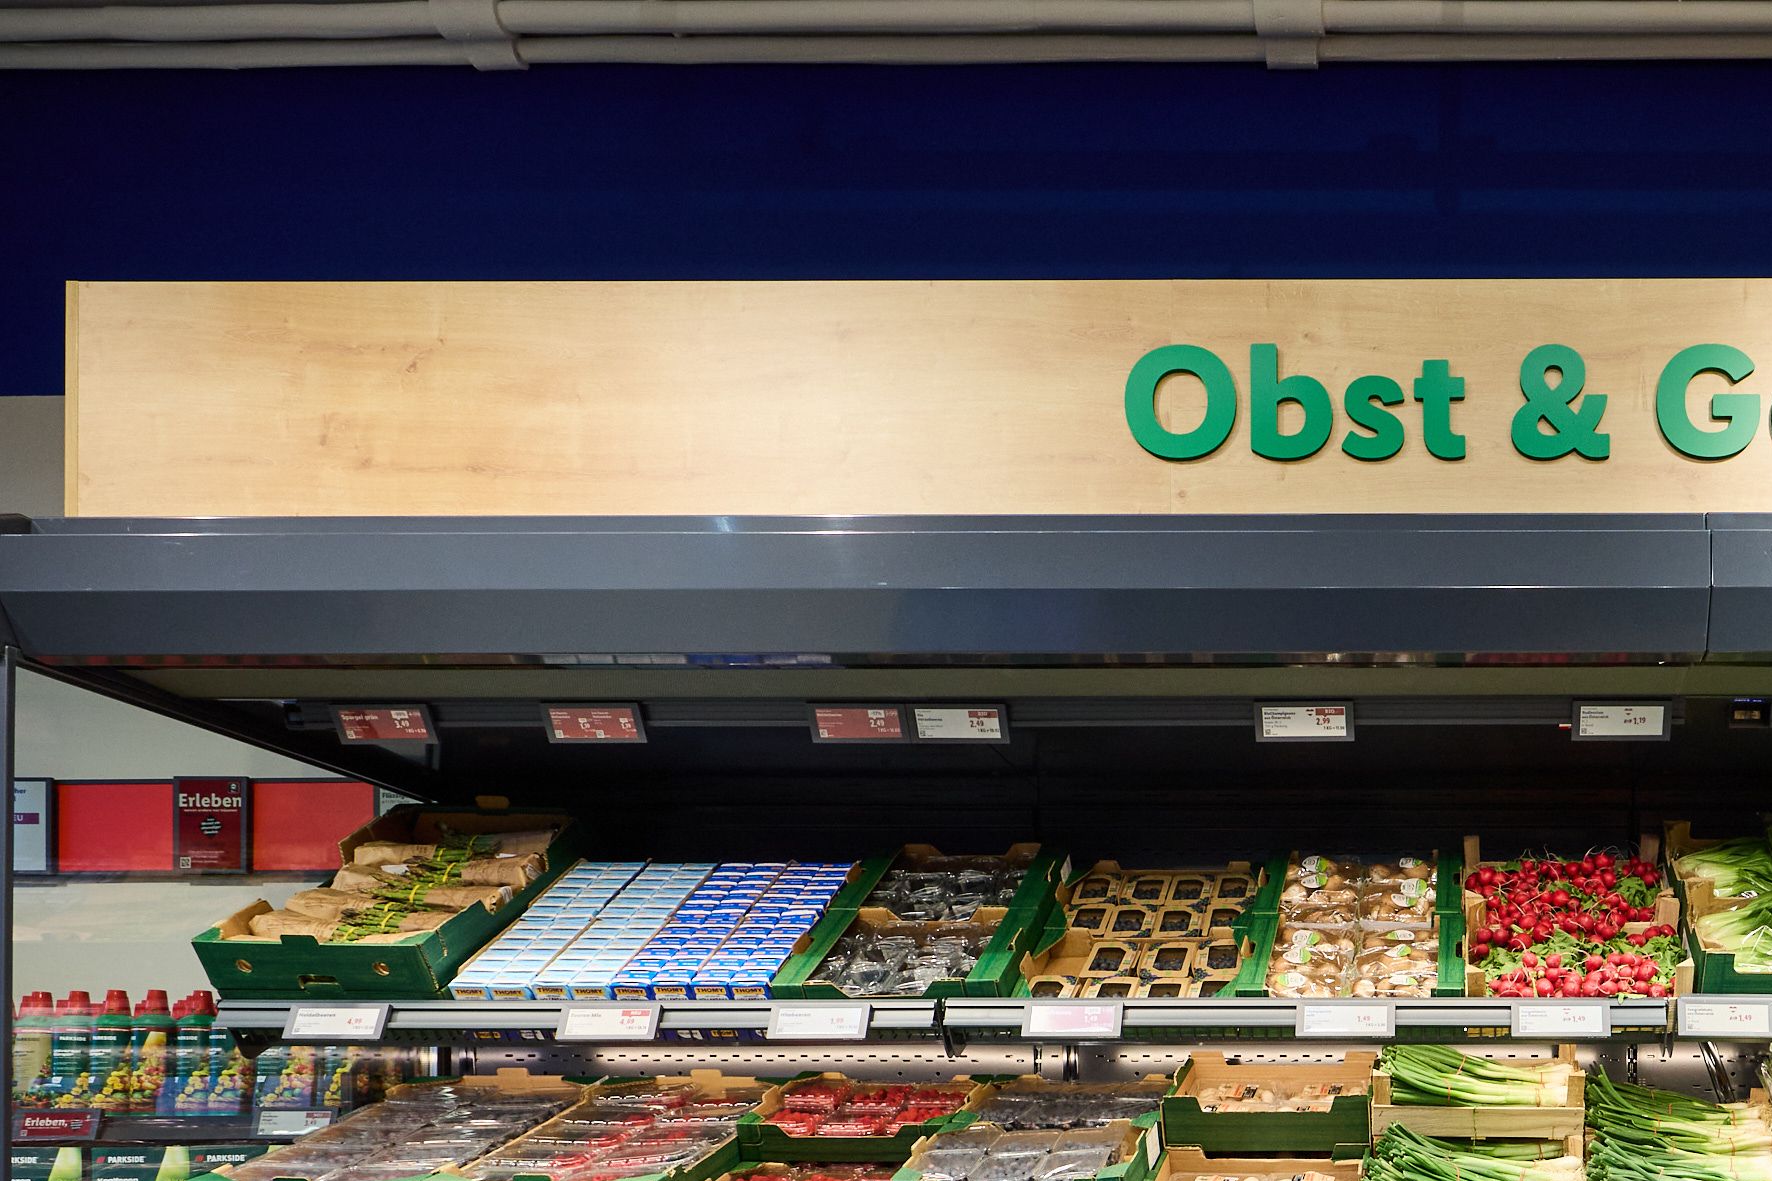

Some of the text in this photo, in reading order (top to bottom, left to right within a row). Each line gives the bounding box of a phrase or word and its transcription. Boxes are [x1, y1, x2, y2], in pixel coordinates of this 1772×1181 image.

[1124, 343, 1466, 460] Obst
[1510, 343, 1611, 460] &
[870, 719, 885, 728] 2.49
[970, 720, 984, 728] 2.49
[1316, 718, 1330, 726] 2.99
[1633, 717, 1646, 725] 1.19
[179, 793, 242, 807] Erleben
[25, 1118, 68, 1127] Erleben,
[108, 1156, 145, 1164] PARKSIDE
